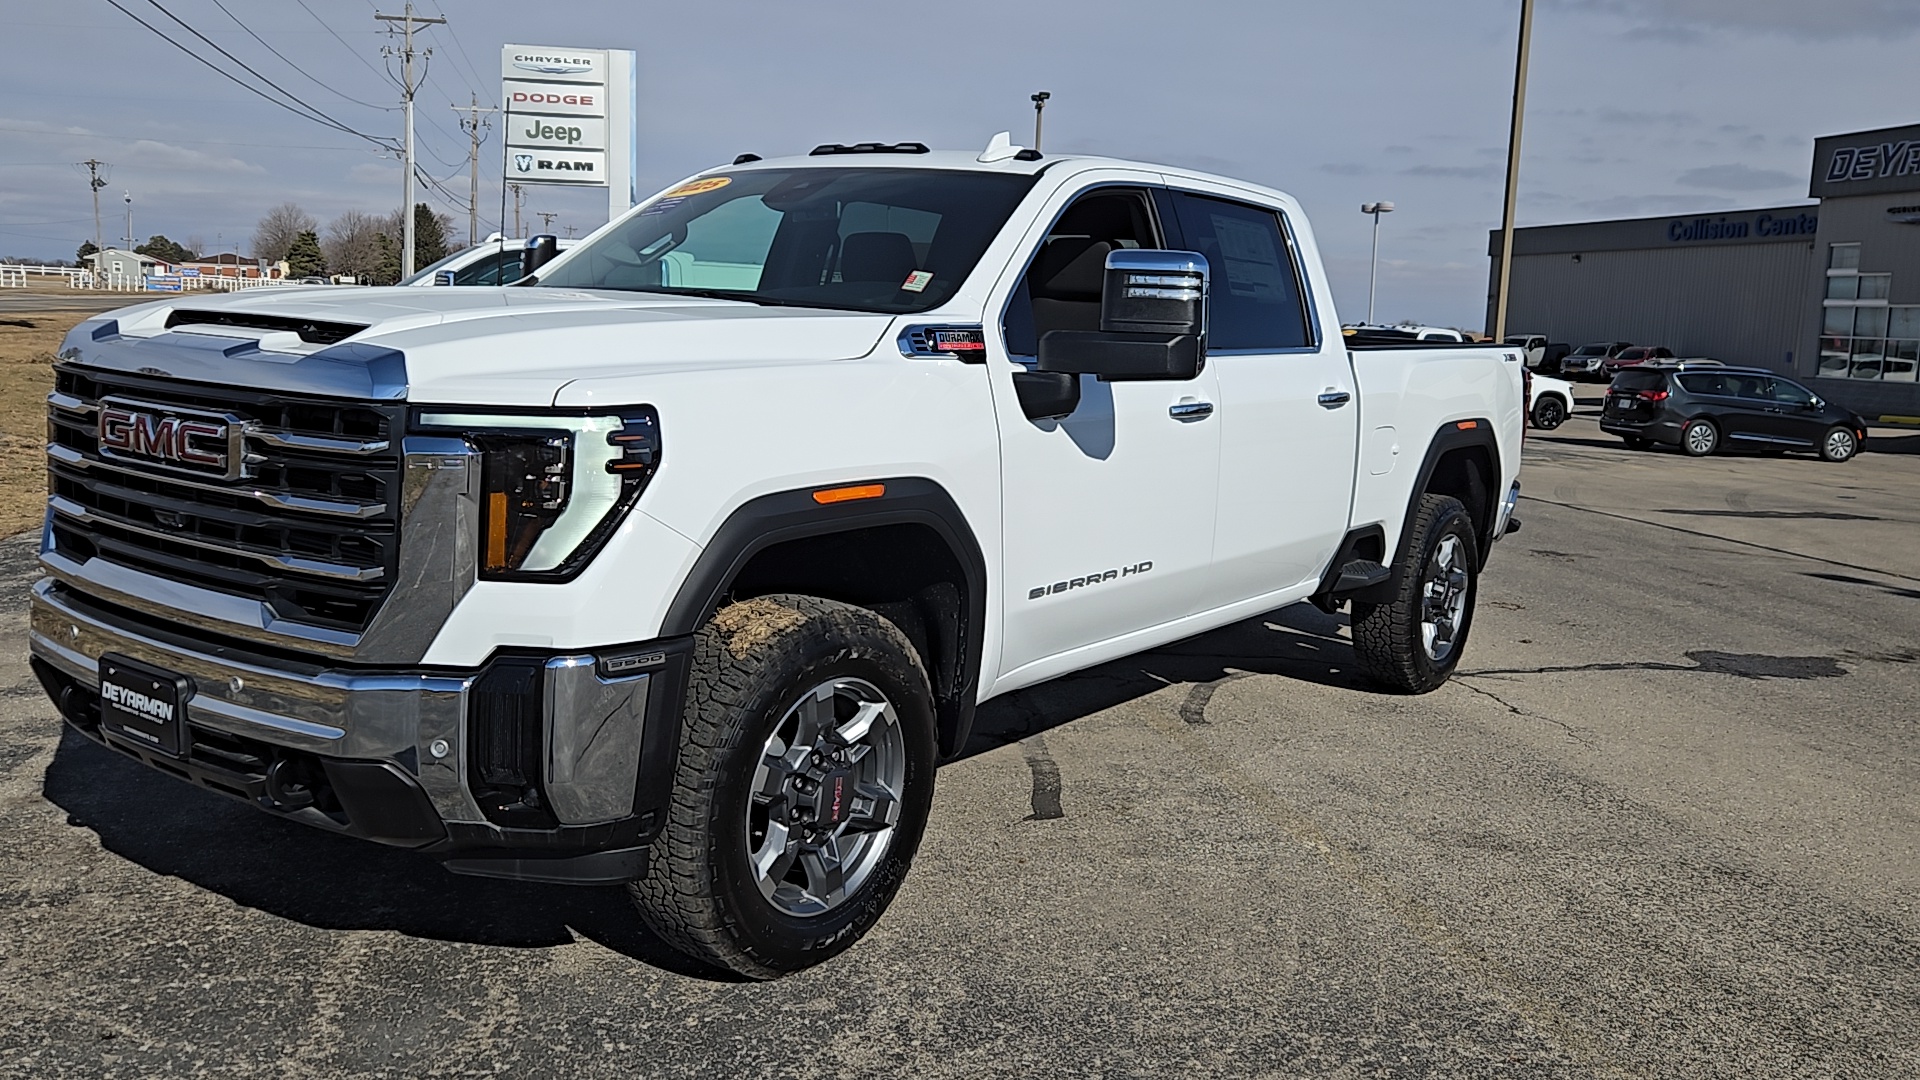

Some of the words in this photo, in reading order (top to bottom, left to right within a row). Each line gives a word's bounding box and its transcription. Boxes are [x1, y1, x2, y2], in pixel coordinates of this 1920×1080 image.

[514, 55, 591, 65] CHRYSLER
[513, 92, 593, 106] DODGE
[525, 120, 582, 144] Jeep
[537, 159, 594, 171] RAM
[1667, 217, 1748, 241] Collision
[939, 332, 981, 343] DURAMAX
[101, 408, 227, 468] GMC
[1027, 569, 1118, 600] SIERRA
[1121, 561, 1153, 577] HD
[101, 680, 174, 722] DEYARMAN
